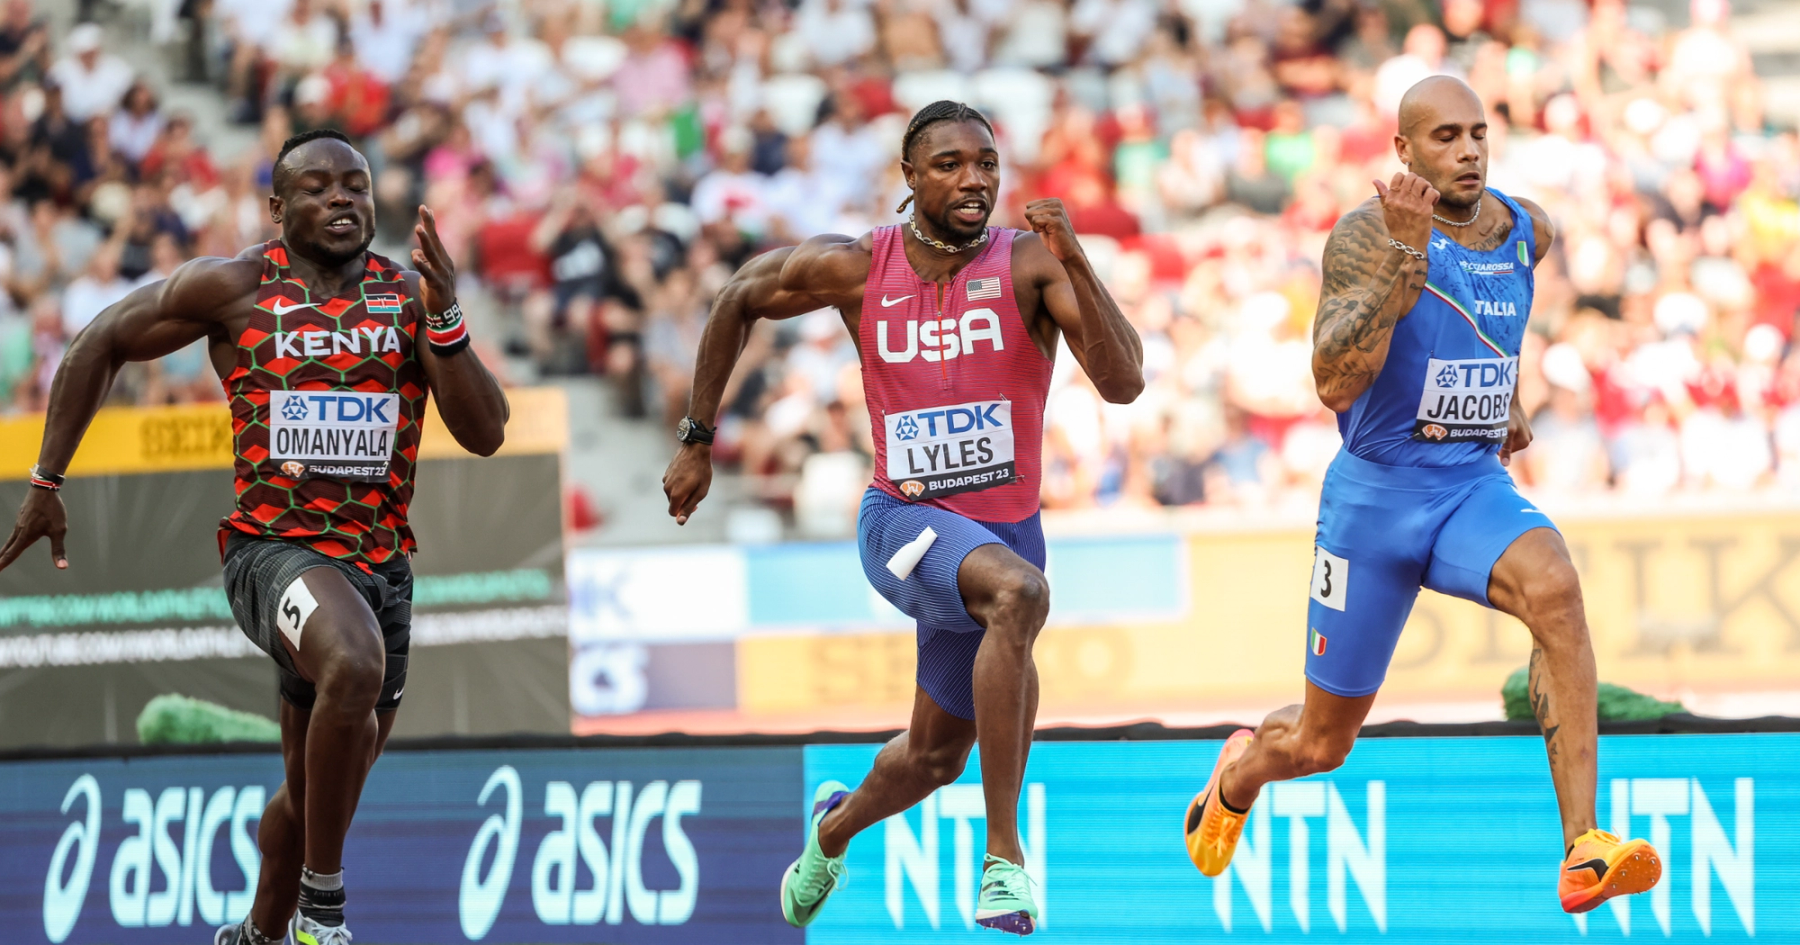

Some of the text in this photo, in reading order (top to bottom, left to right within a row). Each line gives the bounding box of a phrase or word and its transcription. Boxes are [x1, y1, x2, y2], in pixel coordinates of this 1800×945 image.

[274, 326, 401, 358] KENYA
[877, 308, 1004, 363] USA
[1459, 361, 1513, 388] TDK
[308, 395, 391, 423] TDK
[917, 403, 1004, 437] TDK
[1427, 392, 1510, 421] JACOBS
[276, 427, 388, 457] OMANYALA
[907, 437, 994, 474] LYLES
[929, 468, 1009, 491] BUDAPEST 23
[1320, 559, 1332, 598] 3
[282, 596, 301, 631] 5
[109, 785, 264, 927] asics
[531, 780, 702, 925] asics
[1213, 780, 1387, 934] NTN
